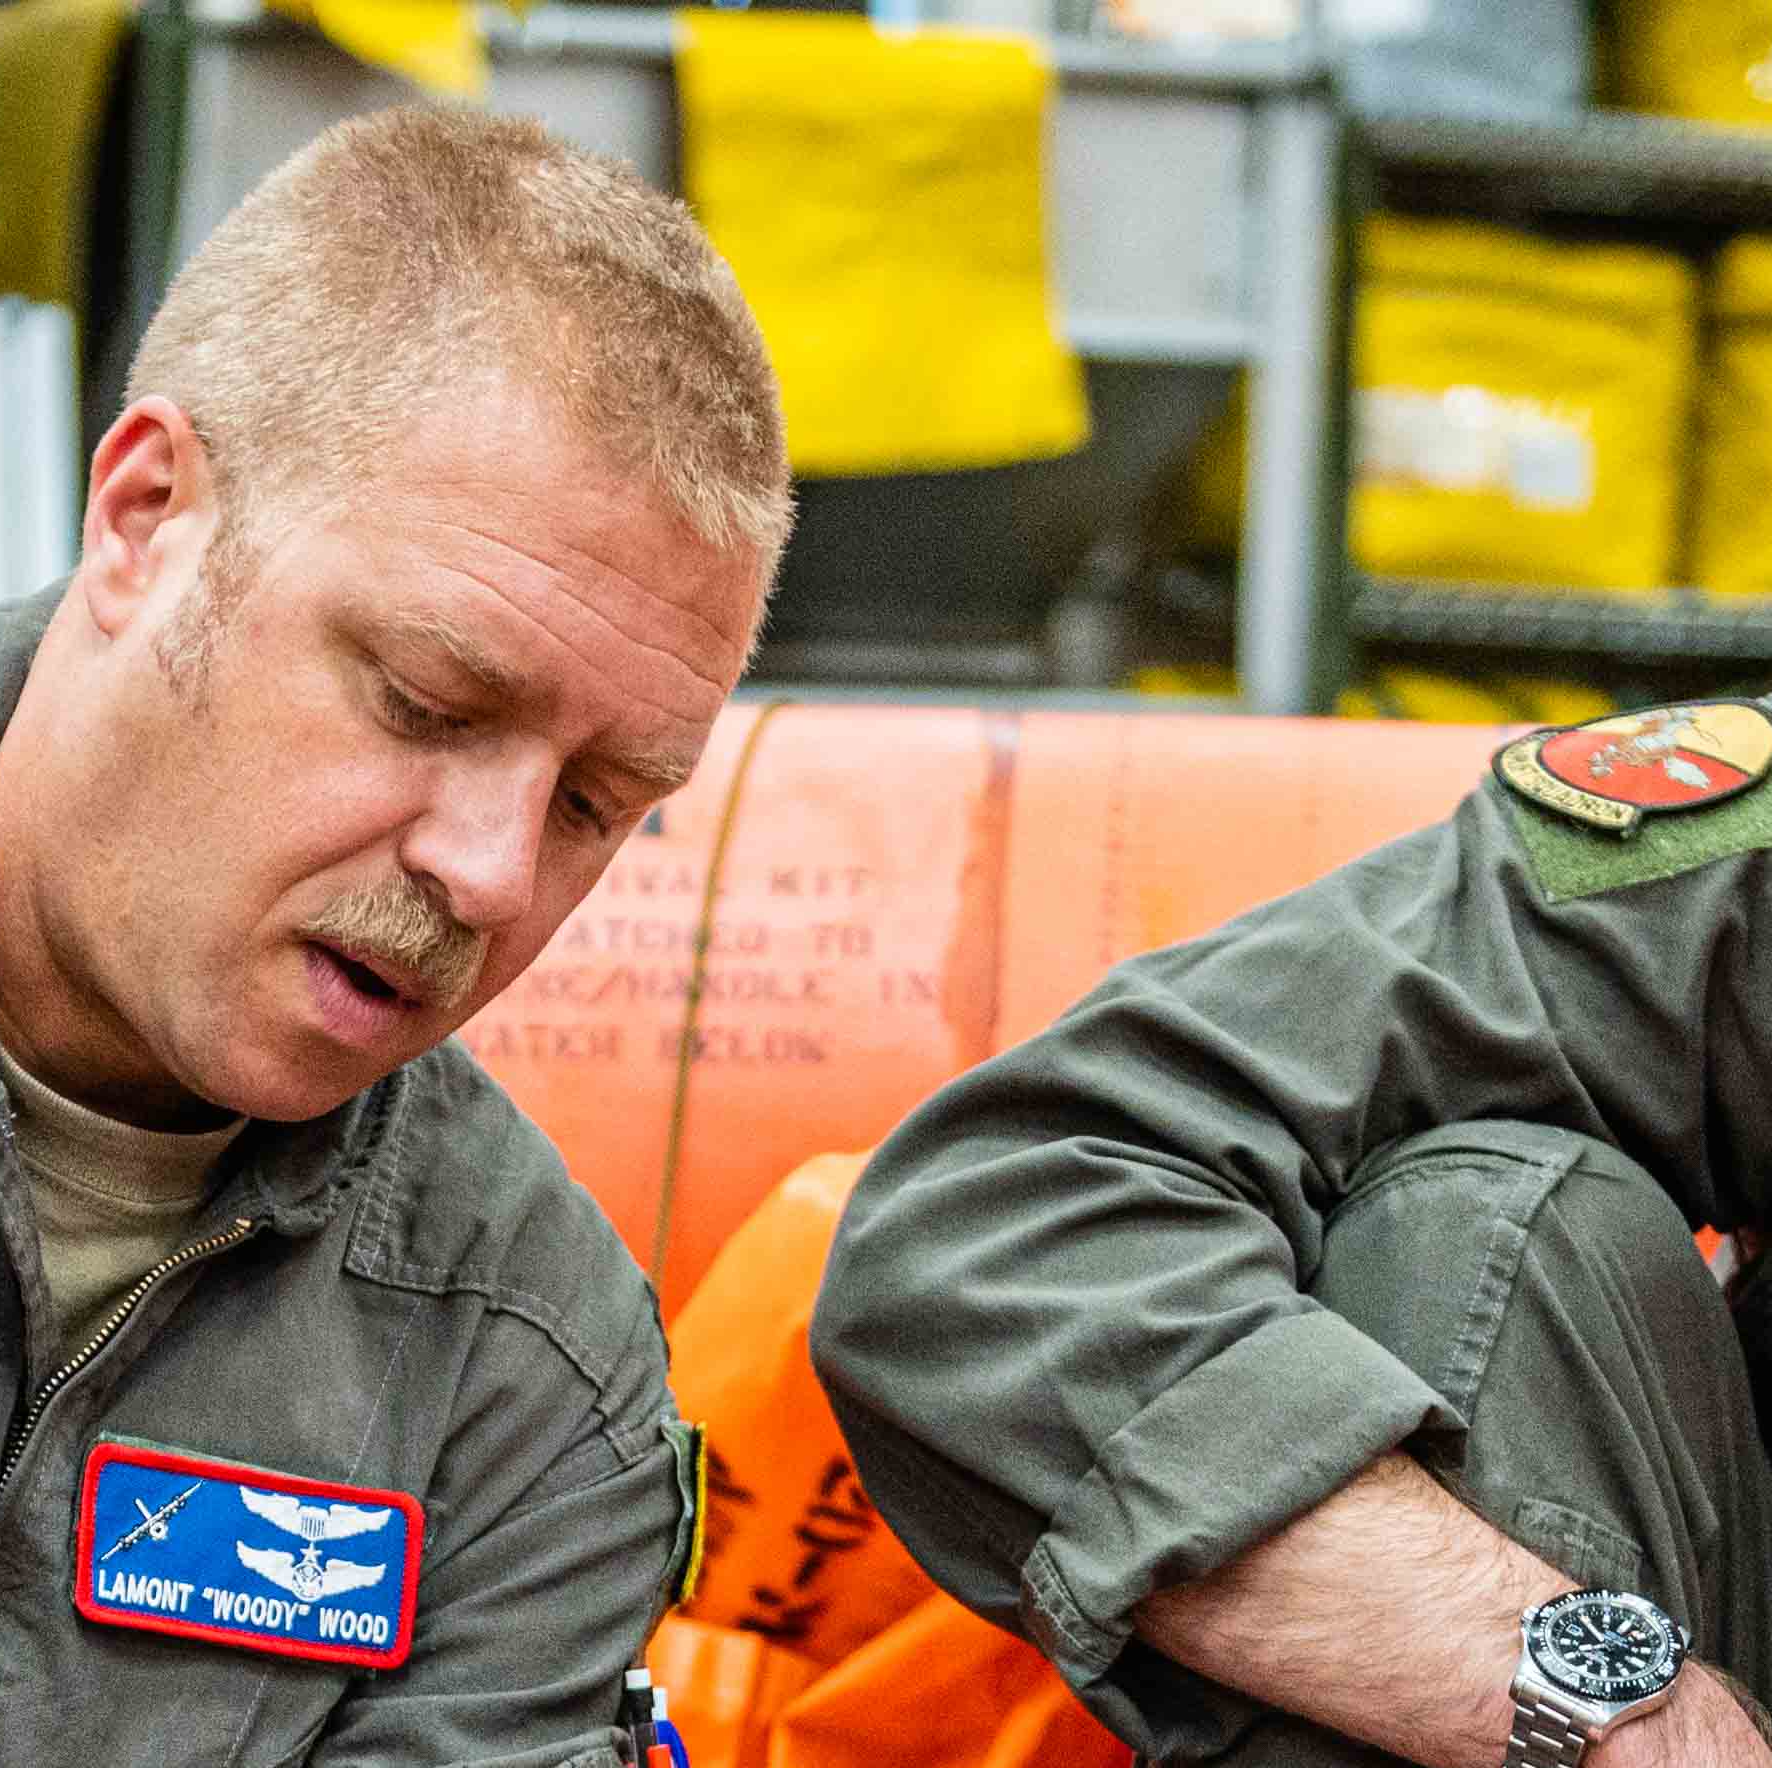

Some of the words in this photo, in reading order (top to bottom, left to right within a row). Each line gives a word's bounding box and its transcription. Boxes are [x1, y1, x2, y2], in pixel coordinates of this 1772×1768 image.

[97, 1568, 195, 1614] LAMONT
[201, 1586, 311, 1632] "WOODY"
[318, 1606, 389, 1645] WOOD
